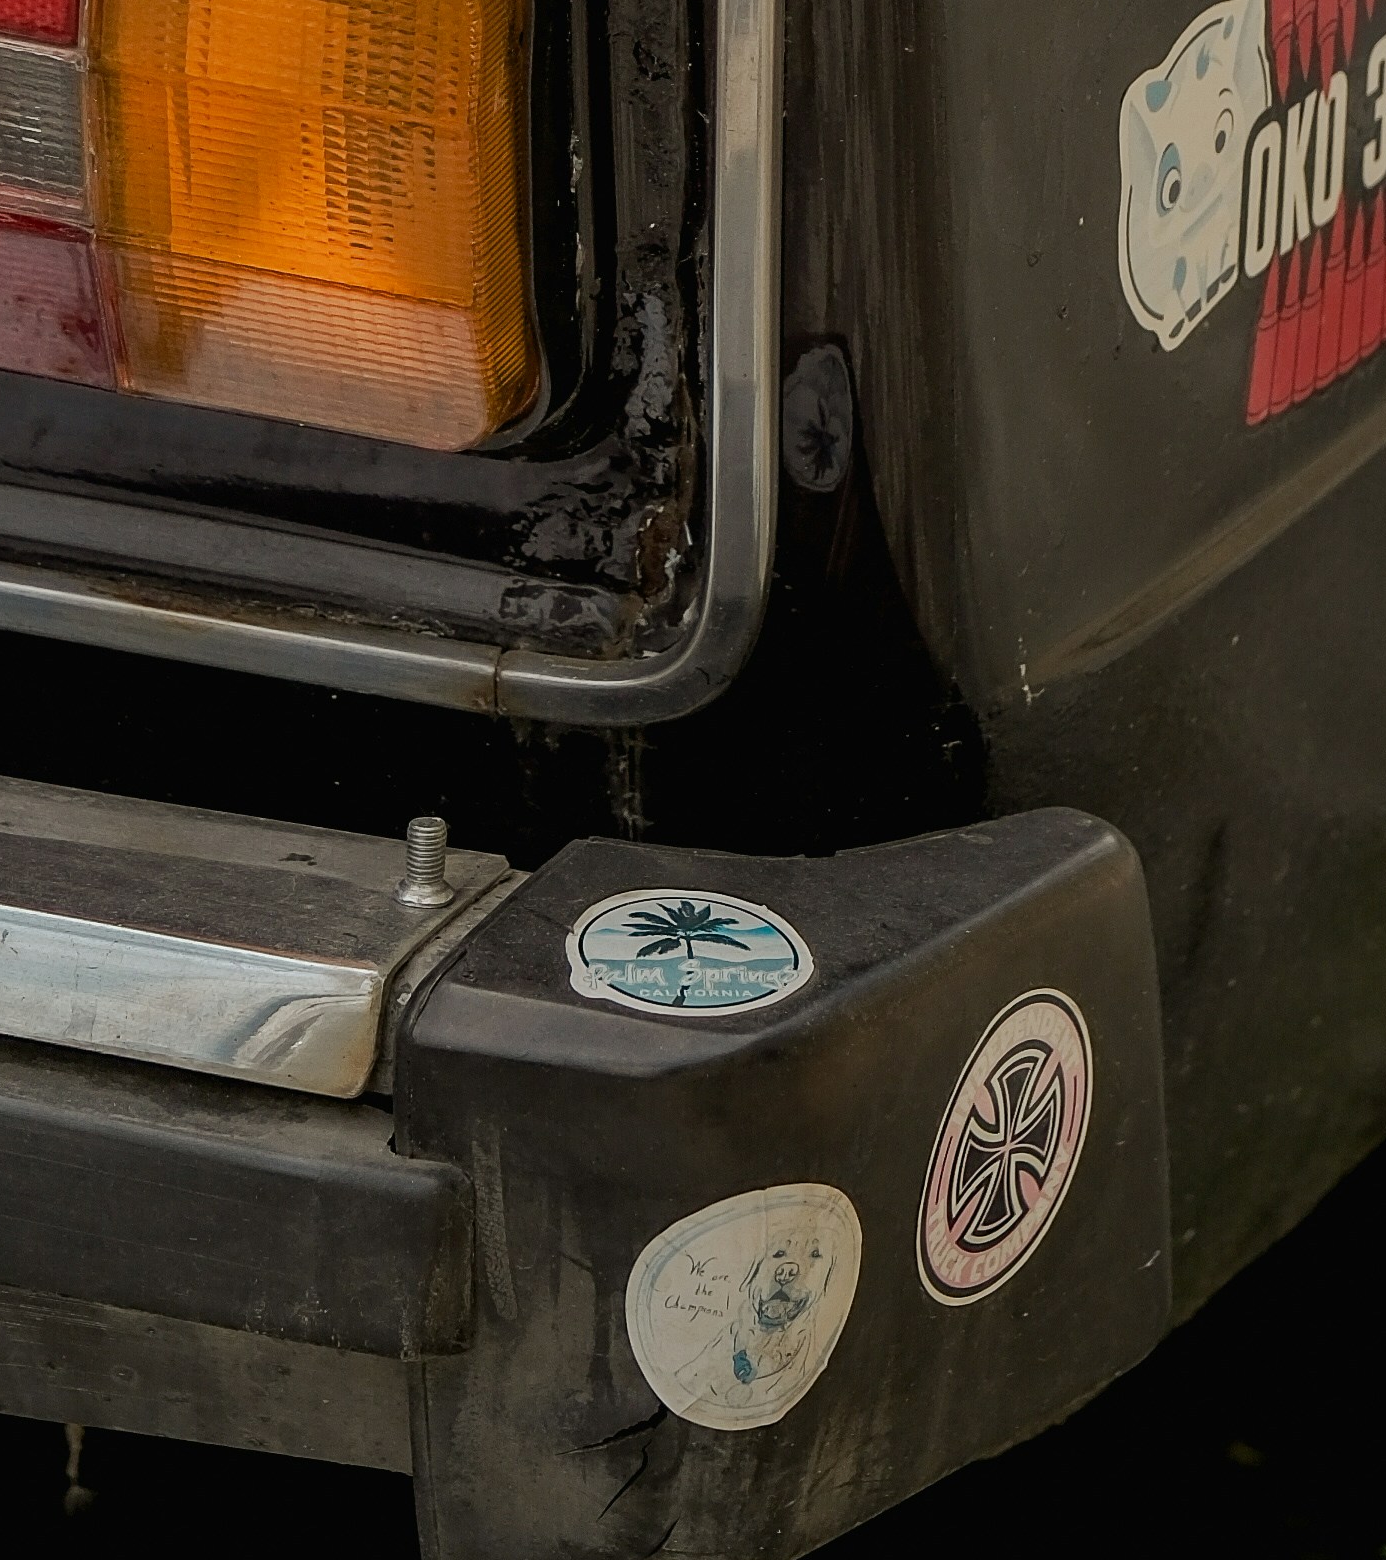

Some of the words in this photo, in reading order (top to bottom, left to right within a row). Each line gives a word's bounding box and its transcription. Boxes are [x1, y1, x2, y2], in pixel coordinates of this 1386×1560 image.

[1244, 70, 1348, 278] ОКО
[584, 961, 668, 990] Palm
[677, 958, 800, 991] Springs
[639, 988, 754, 998] CALIFORNIA
[926, 1199, 966, 1282] TRUCK
[969, 1144, 1069, 1280] COMPANY
[685, 1254, 717, 1277] We
